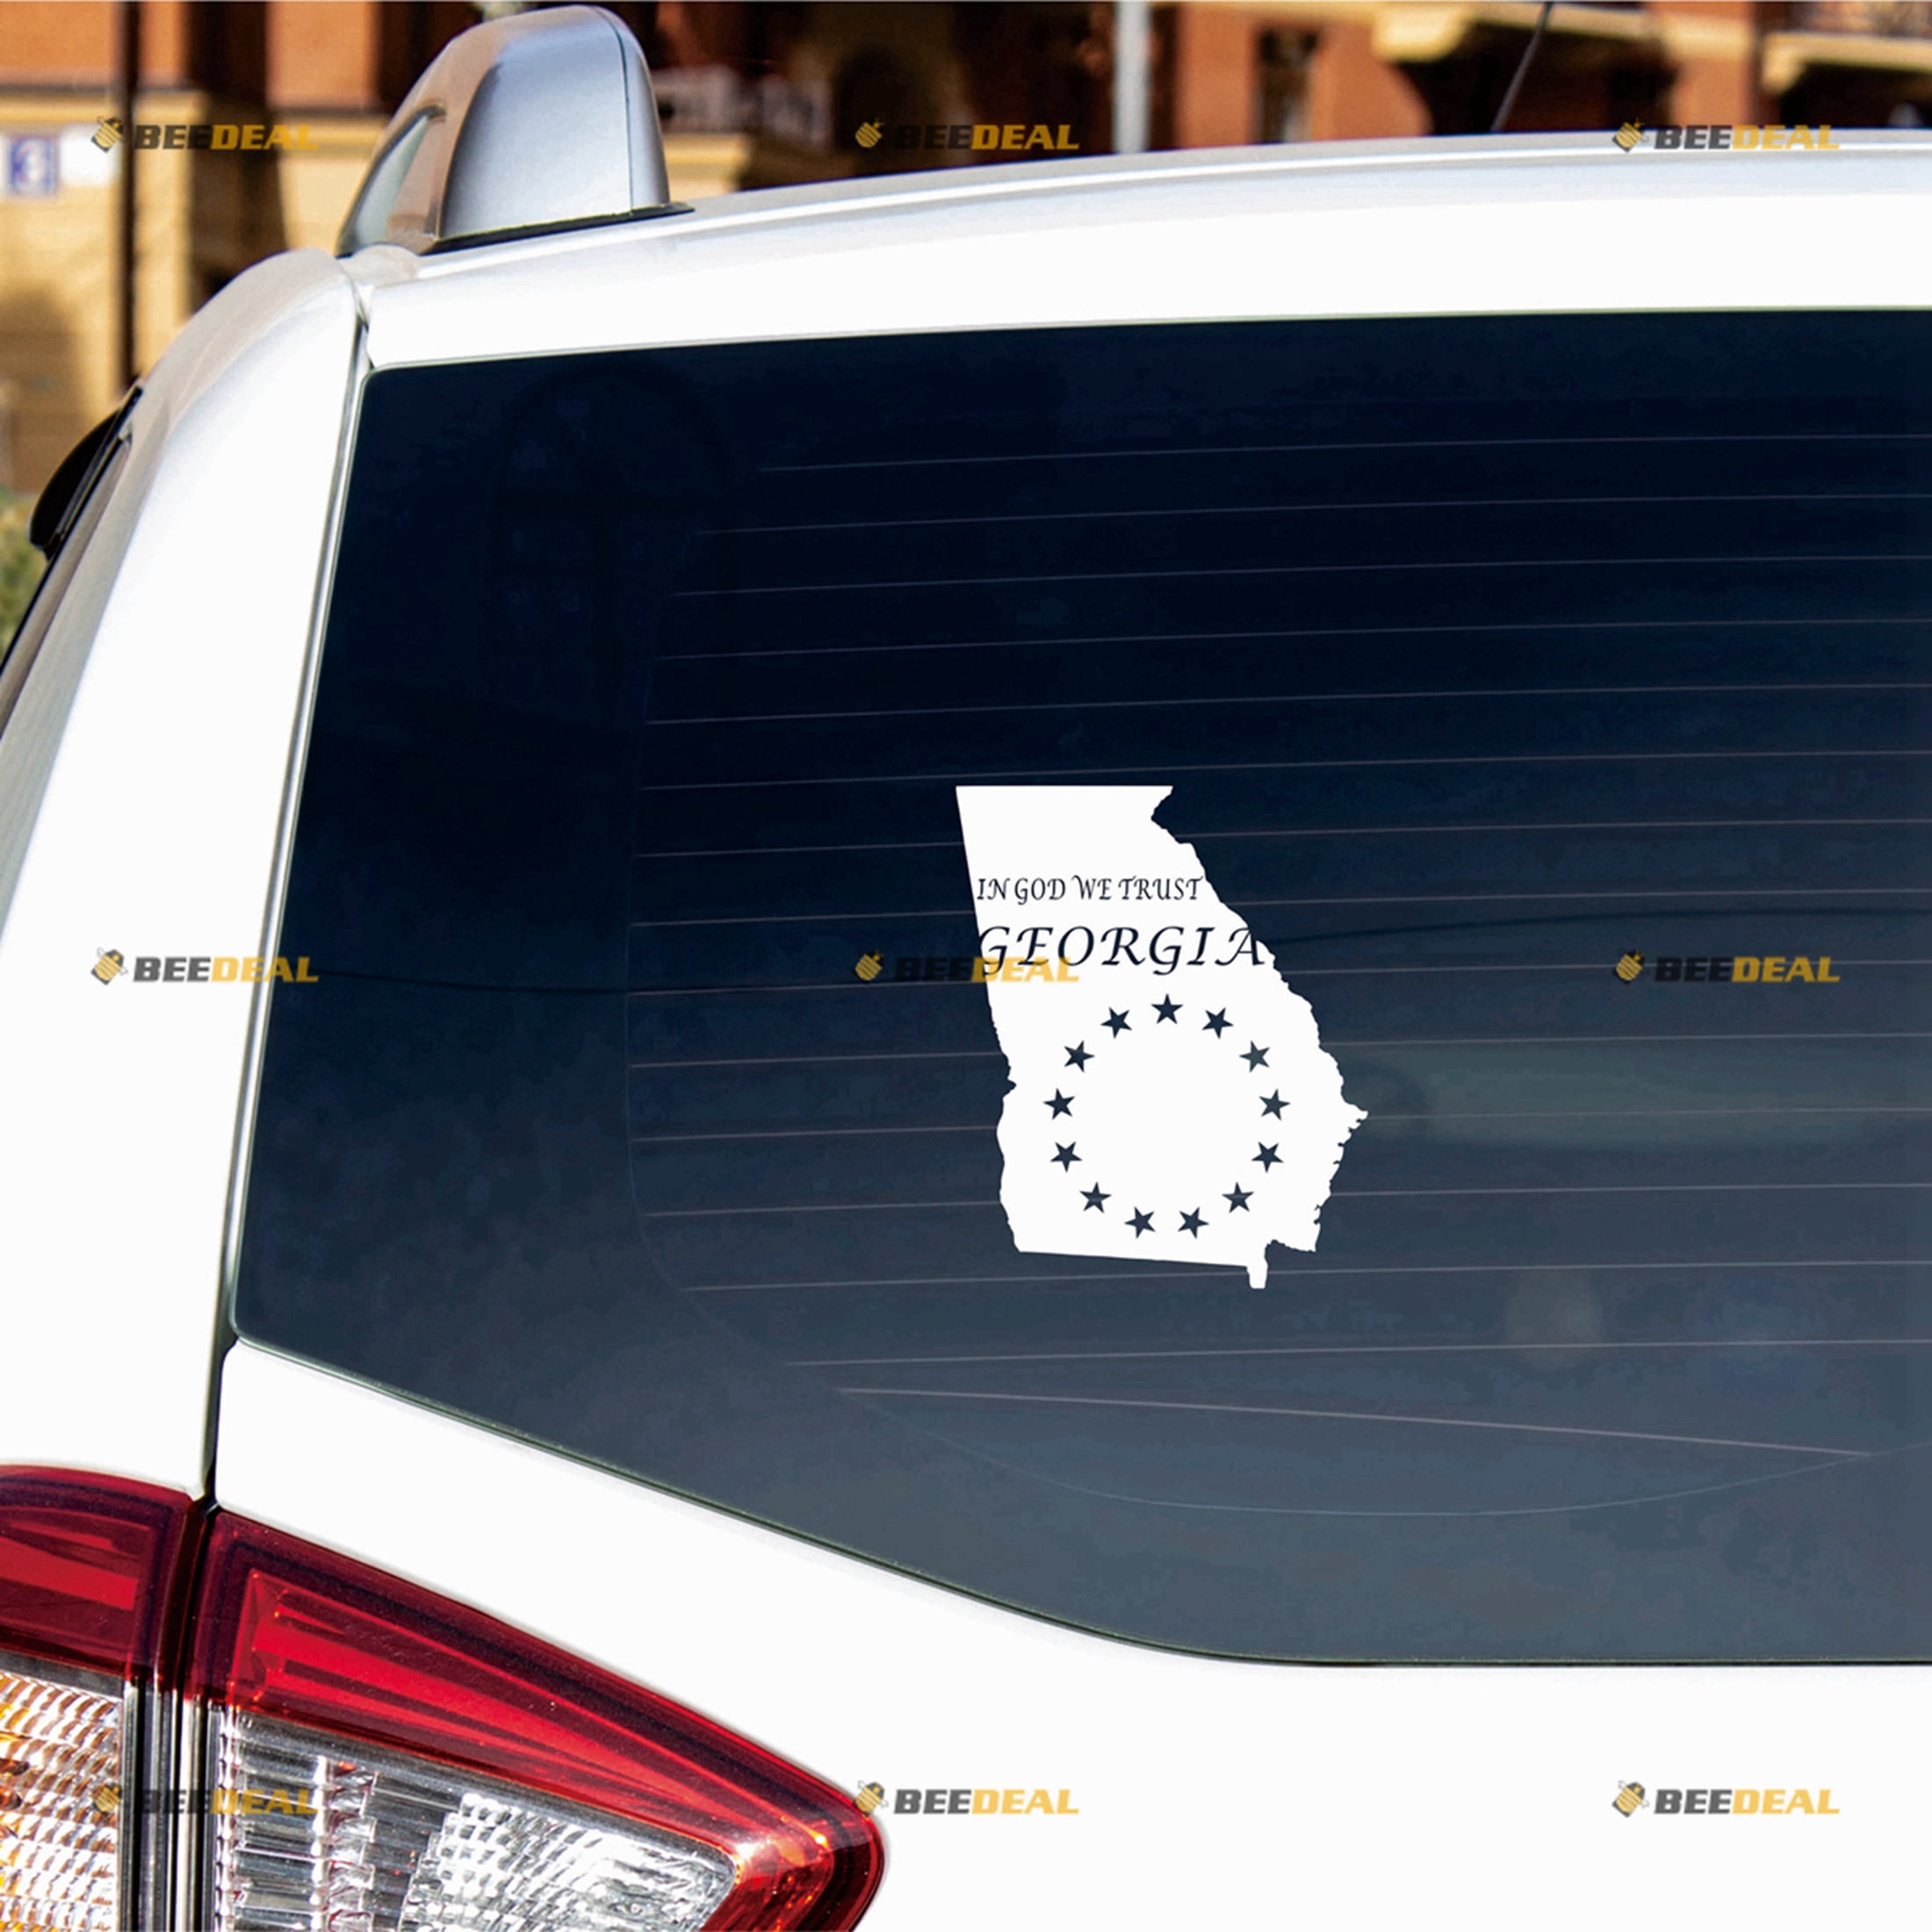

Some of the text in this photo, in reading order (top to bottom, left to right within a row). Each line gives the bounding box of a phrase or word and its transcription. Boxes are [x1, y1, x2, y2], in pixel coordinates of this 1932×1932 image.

[977, 875, 1202, 905] IN GOD WE TRUST
[979, 926, 1265, 976] GEORGIA
